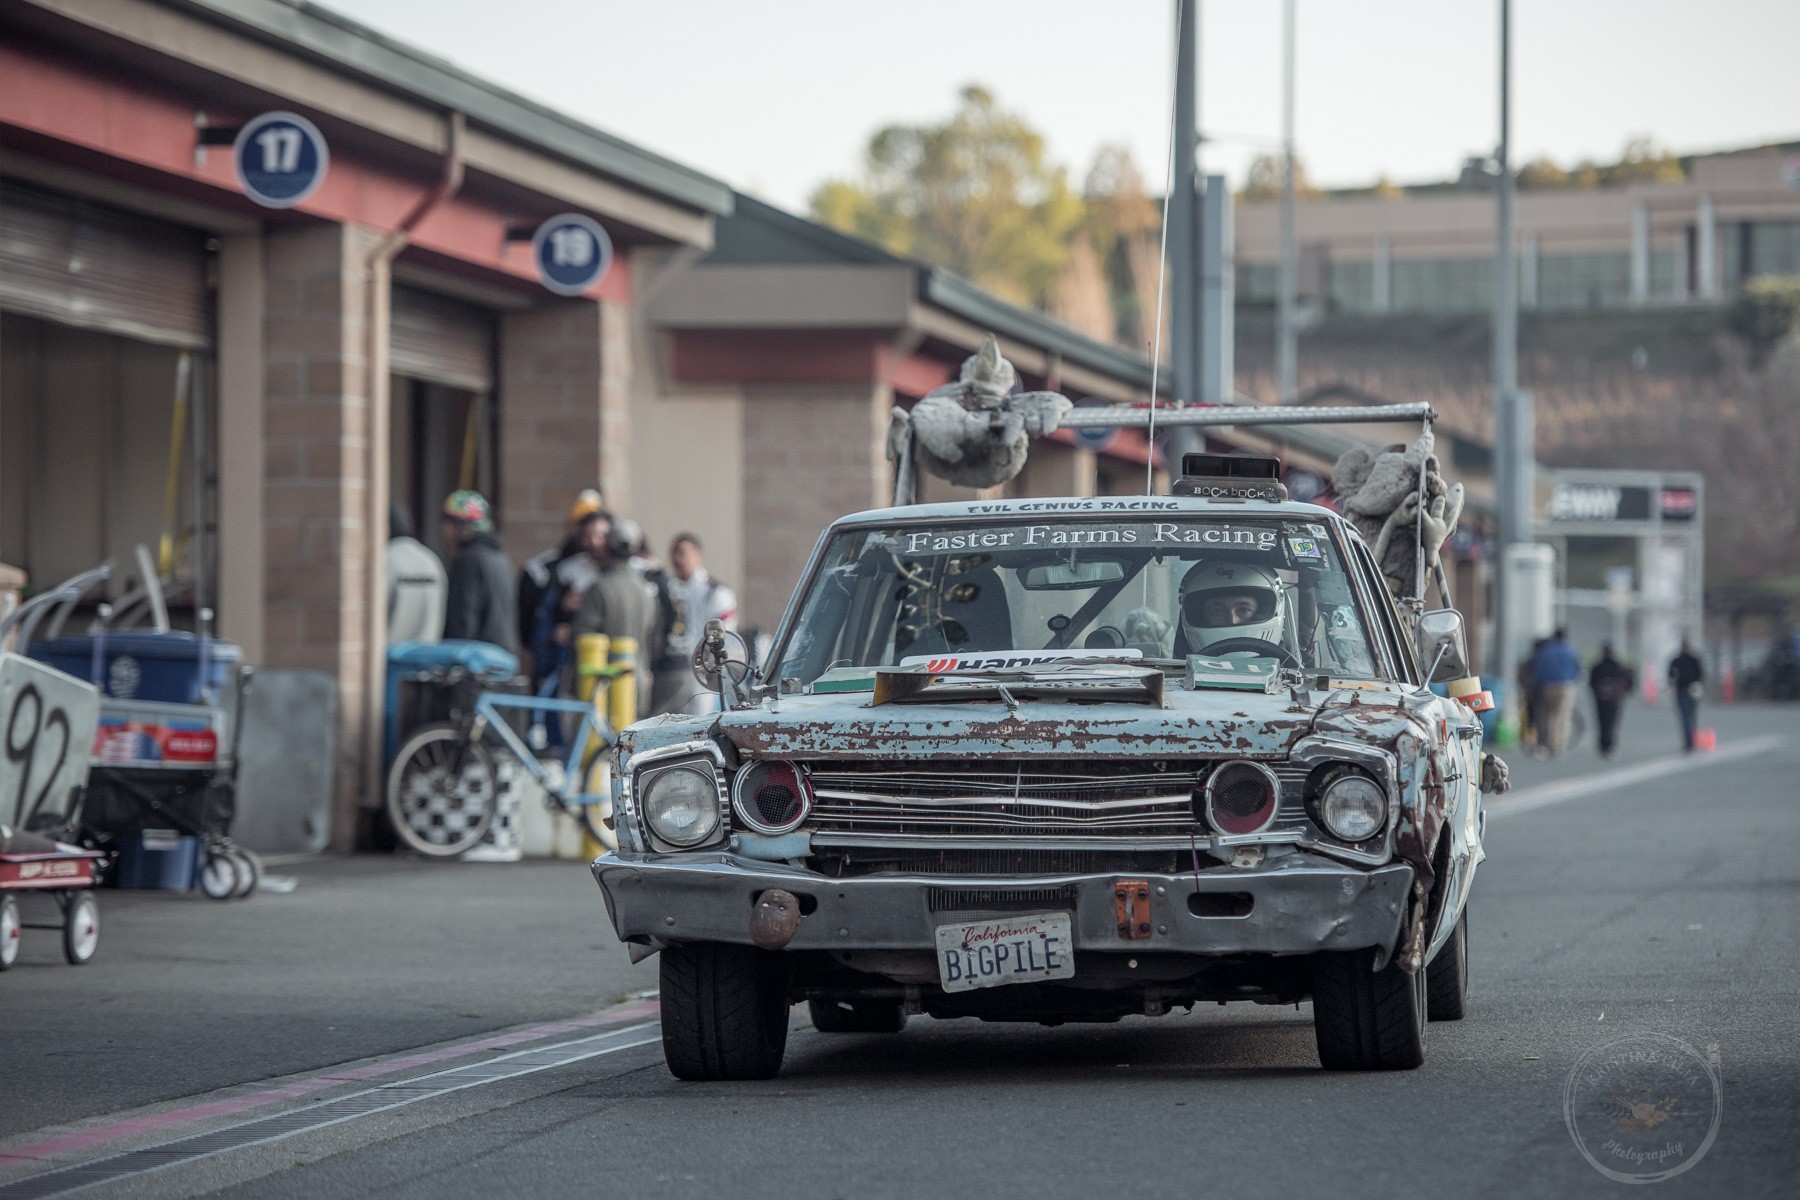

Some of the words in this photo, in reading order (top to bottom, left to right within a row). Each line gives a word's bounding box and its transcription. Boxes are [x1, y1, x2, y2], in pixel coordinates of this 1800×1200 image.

[256, 128, 302, 173] 17
[967, 504, 1012, 514] EVIL
[1018, 501, 1093, 511] GENIUS
[1100, 501, 1179, 510] RACING
[905, 531, 1014, 553] Faster
[1022, 525, 1137, 546] Farms
[1151, 523, 1278, 551] Racing
[7, 682, 82, 831] 92
[964, 924, 1046, 944] California
[944, 937, 1062, 983] BIGPILE
